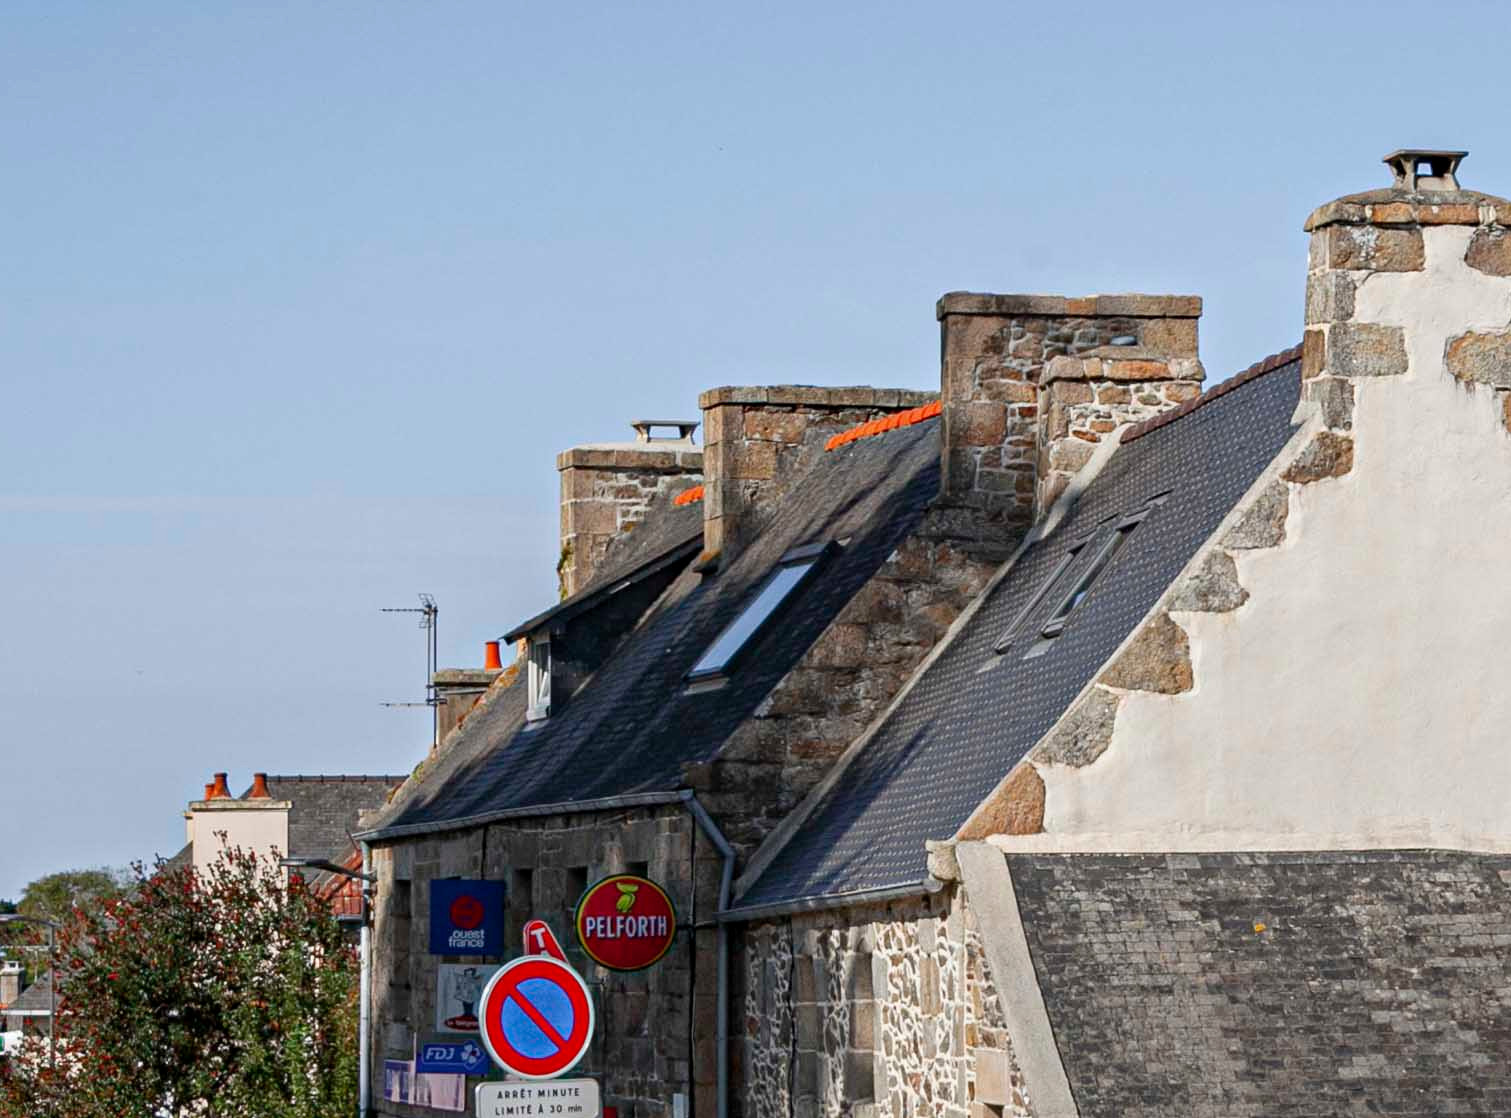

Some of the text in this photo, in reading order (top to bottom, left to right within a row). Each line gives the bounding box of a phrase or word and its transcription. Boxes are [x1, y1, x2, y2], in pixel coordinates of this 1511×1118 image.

[585, 915, 667, 938] PELFORTH
[452, 929, 485, 939] ouest
[448, 936, 485, 948] france
[426, 1047, 455, 1060] FDJ
[497, 1087, 580, 1099] ARRÊT MINUTE
[495, 1103, 583, 1116] LIMITÉ À 30 min
